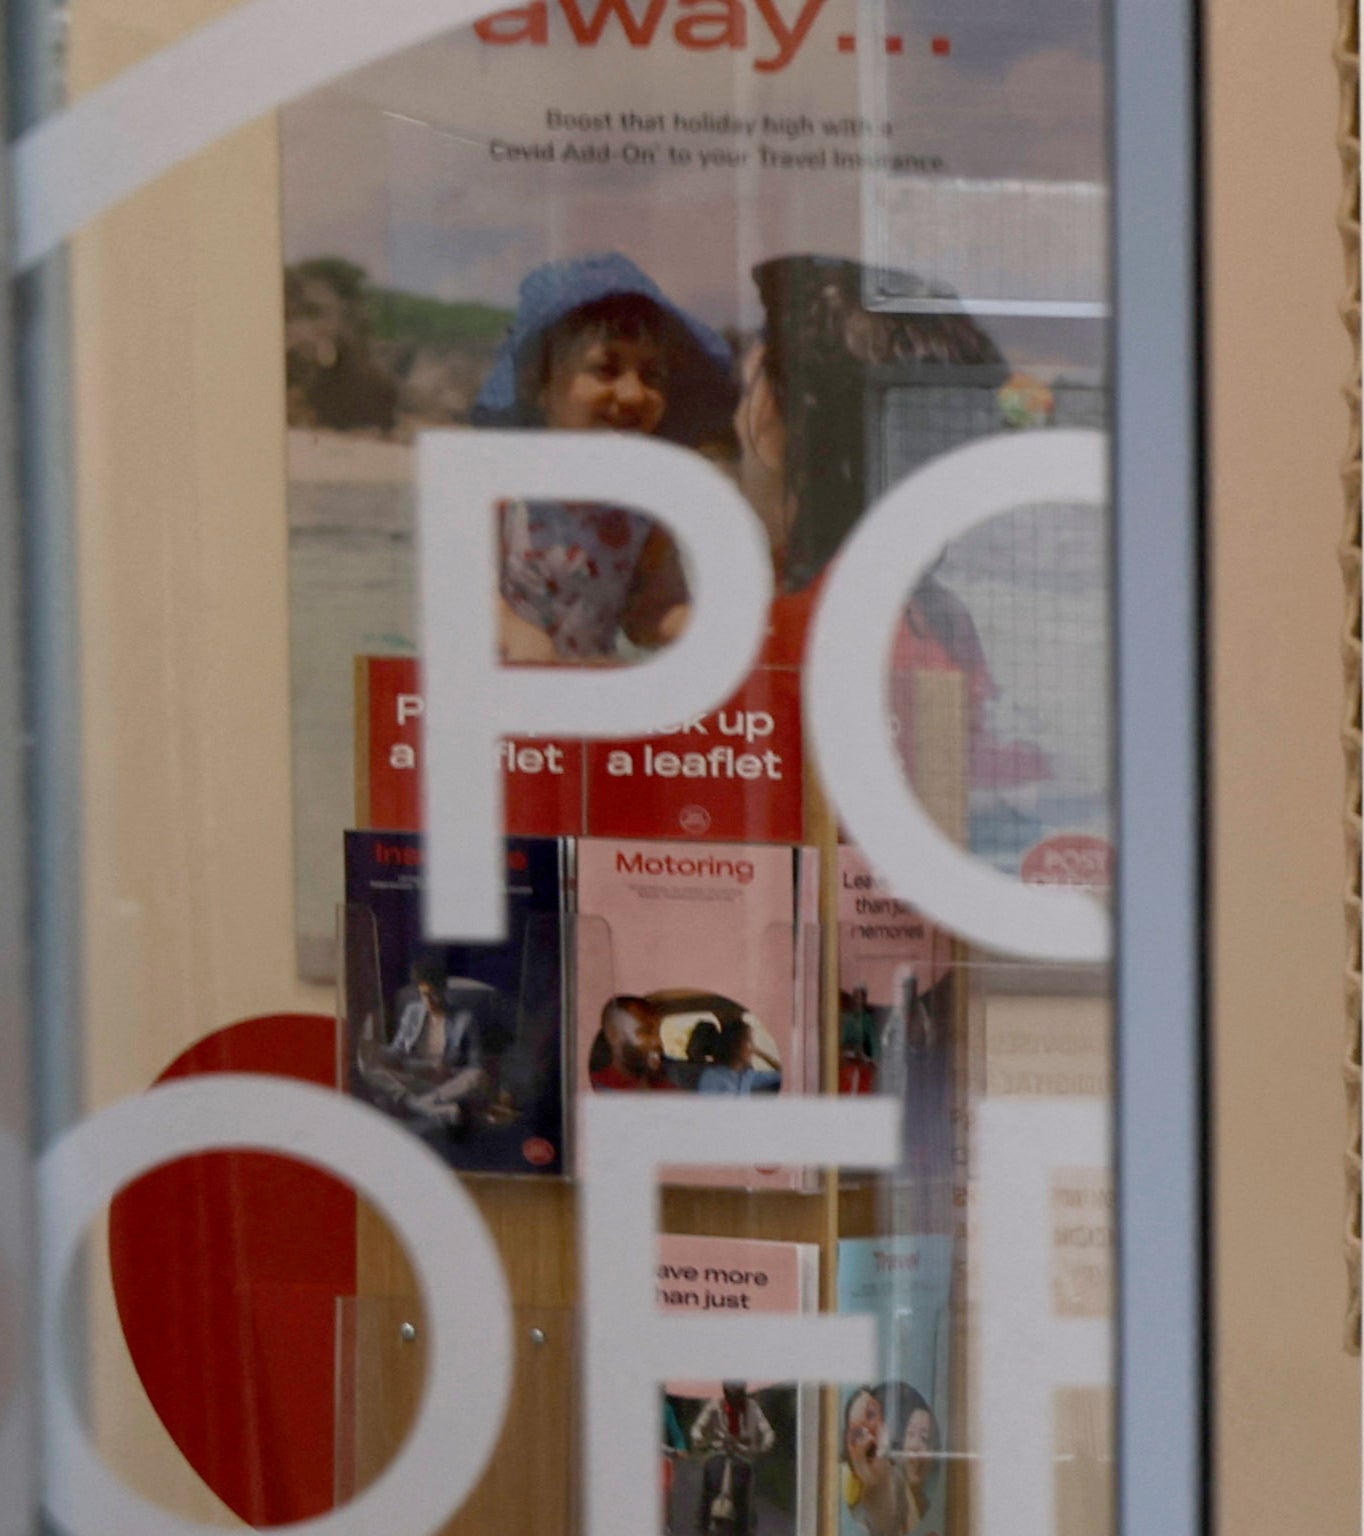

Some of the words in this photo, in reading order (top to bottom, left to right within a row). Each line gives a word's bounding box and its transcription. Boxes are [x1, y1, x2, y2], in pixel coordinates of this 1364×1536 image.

[547, 108, 610, 131] Boost
[620, 109, 665, 131] that
[674, 111, 757, 136] holiday
[763, 113, 814, 139] high
[489, 138, 555, 162] Covid
[668, 145, 692, 162] to
[758, 144, 826, 169] Travel
[717, 710, 775, 744] up
[389, 742, 416, 770] a
[607, 748, 633, 777] a
[644, 745, 783, 781] leaflet
[615, 851, 754, 881] Motoring
[704, 1267, 769, 1286] more
[702, 1288, 751, 1310] just
